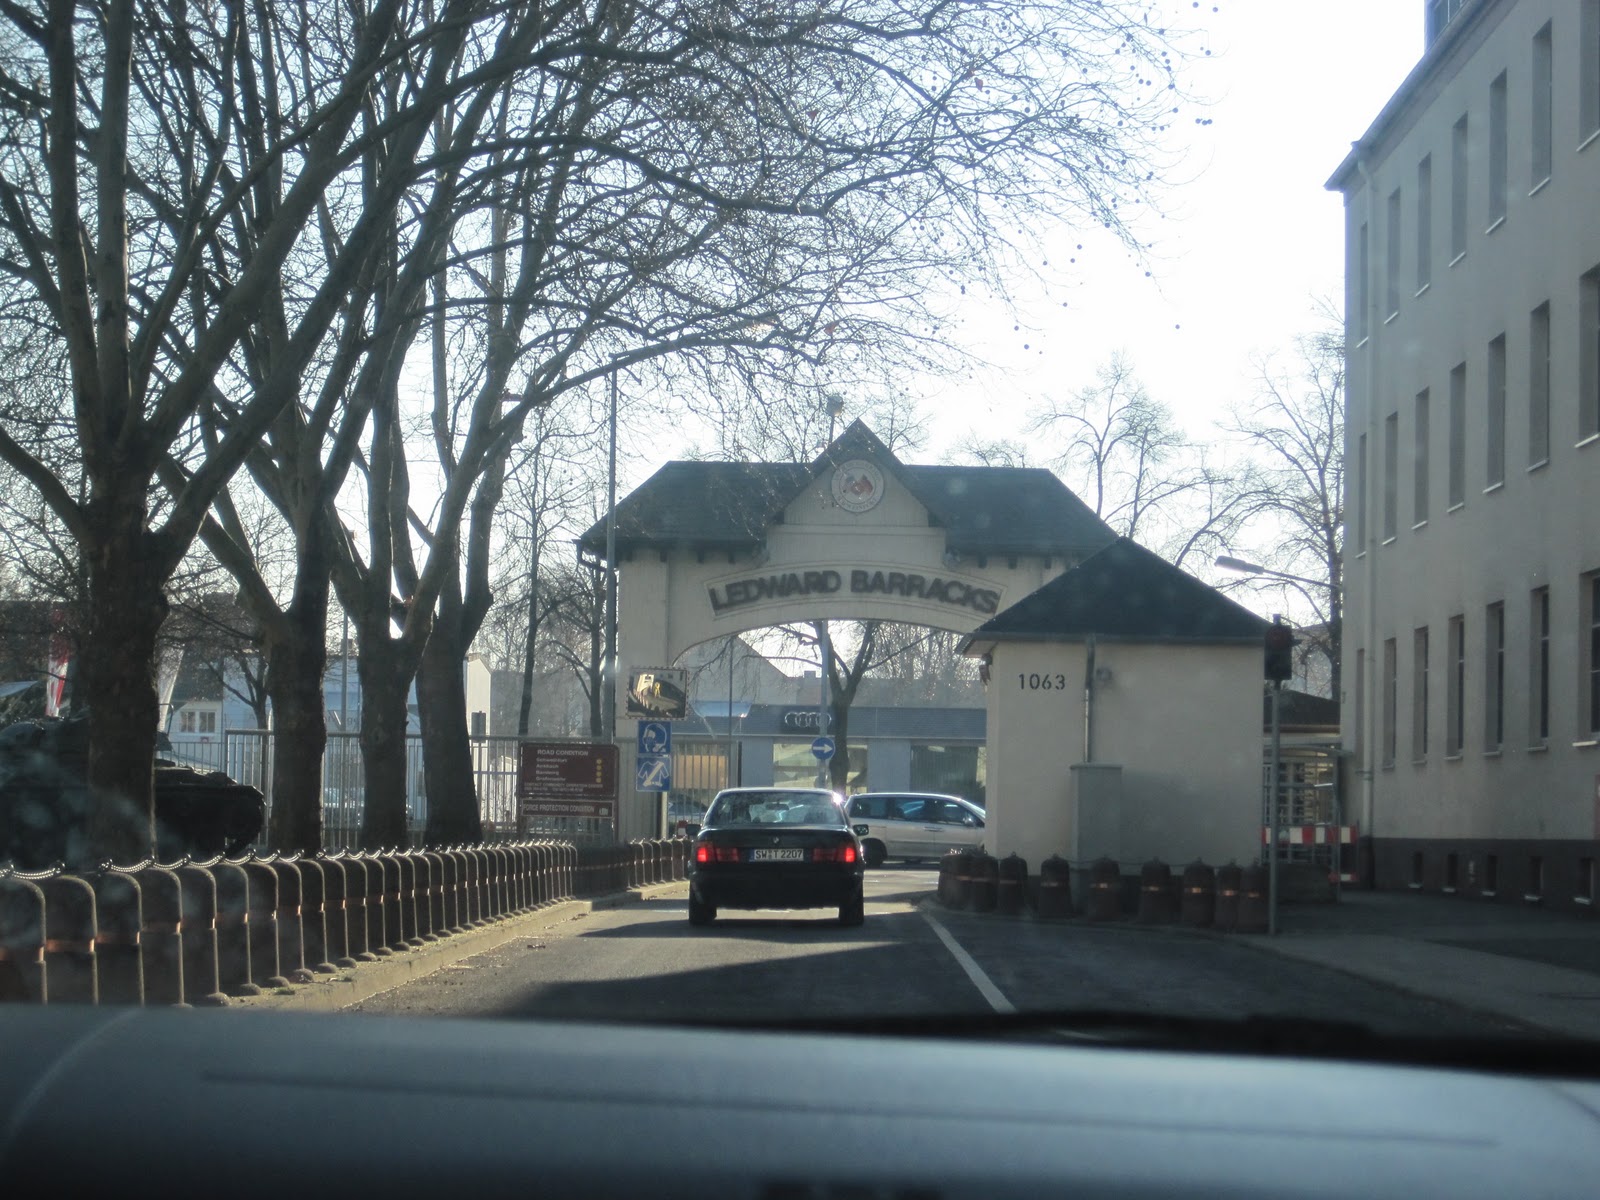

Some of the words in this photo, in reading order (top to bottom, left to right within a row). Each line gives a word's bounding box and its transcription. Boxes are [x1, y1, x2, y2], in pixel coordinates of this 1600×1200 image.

[709, 570, 841, 610] LEDWARD
[850, 569, 999, 613] BARRACKS
[1018, 673, 1066, 690] 1063
[539, 804, 569, 812] PROTECTION
[756, 849, 767, 859] SW
[780, 849, 803, 859] 2207
